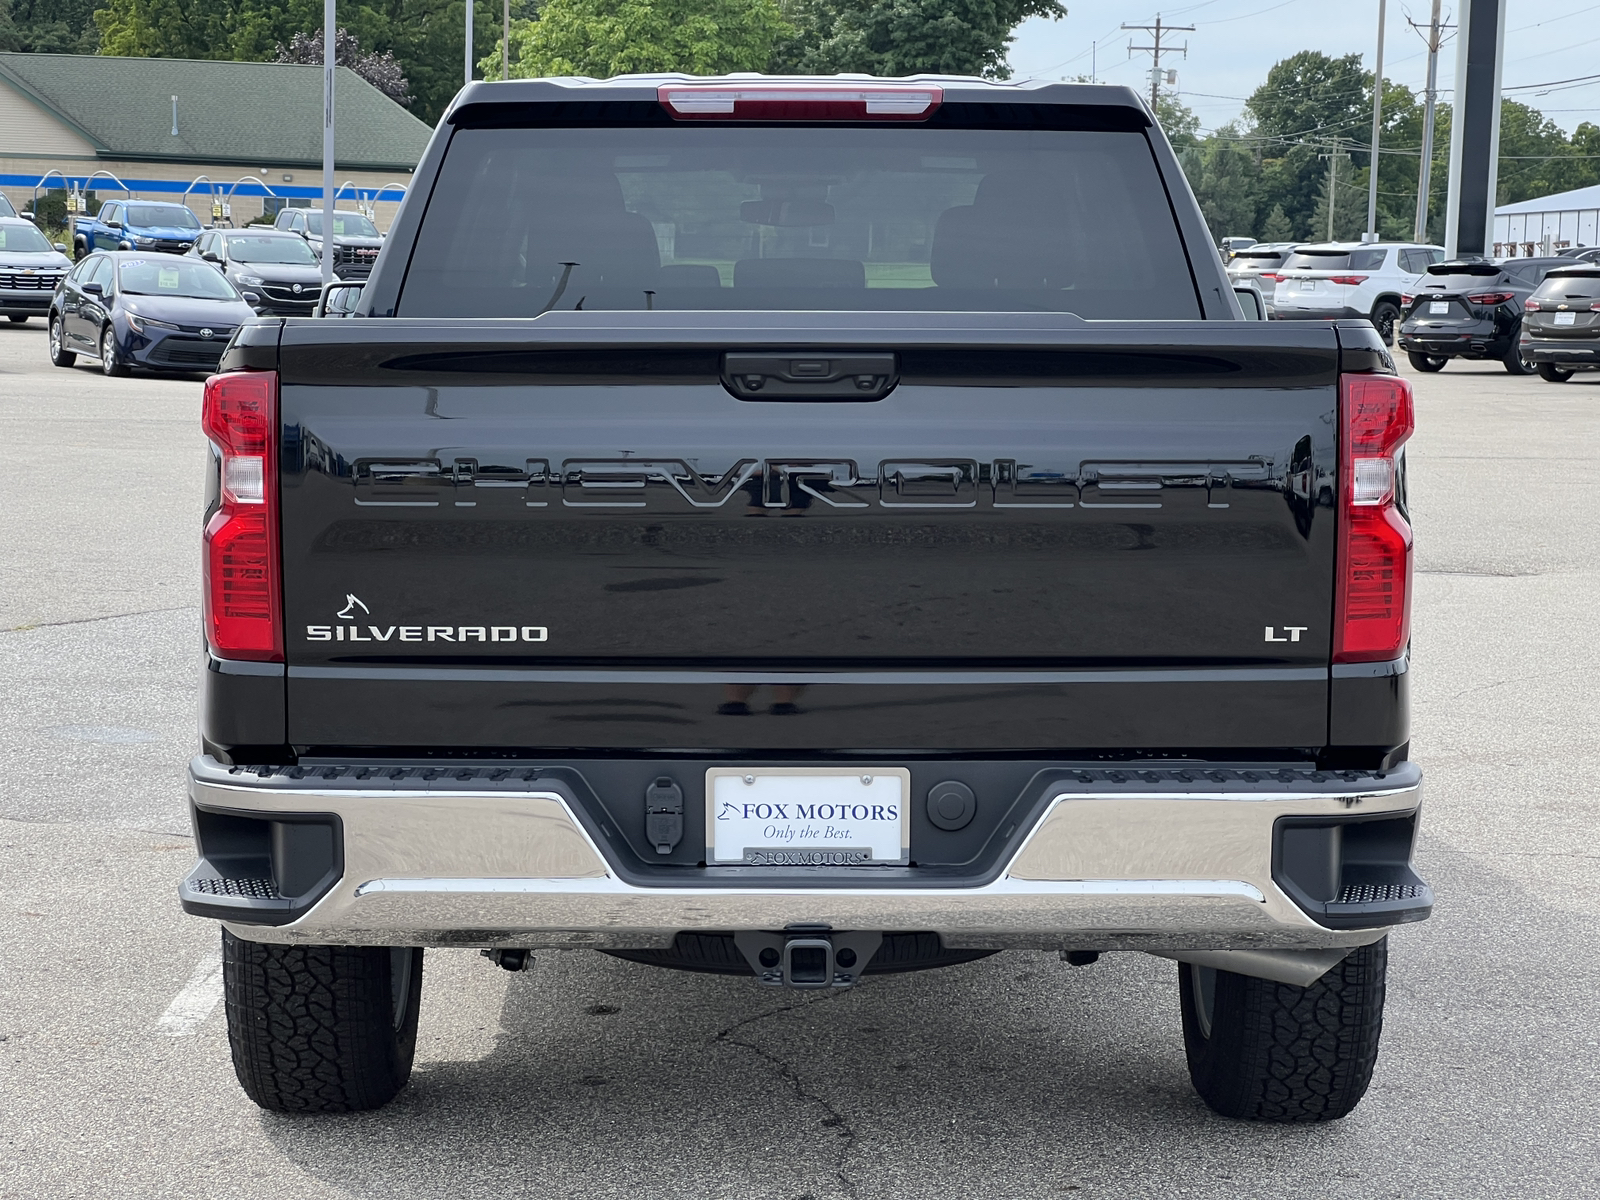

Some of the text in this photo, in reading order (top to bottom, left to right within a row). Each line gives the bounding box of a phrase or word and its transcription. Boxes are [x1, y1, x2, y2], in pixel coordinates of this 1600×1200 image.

[353, 457, 1264, 508] CHEVROLET
[306, 625, 549, 642] SILVERADO
[1264, 626, 1308, 642] LT
[741, 803, 898, 821] FOX MOTORS
[763, 824, 853, 843] Only the Best.
[765, 851, 863, 866] FOX MOTORS
